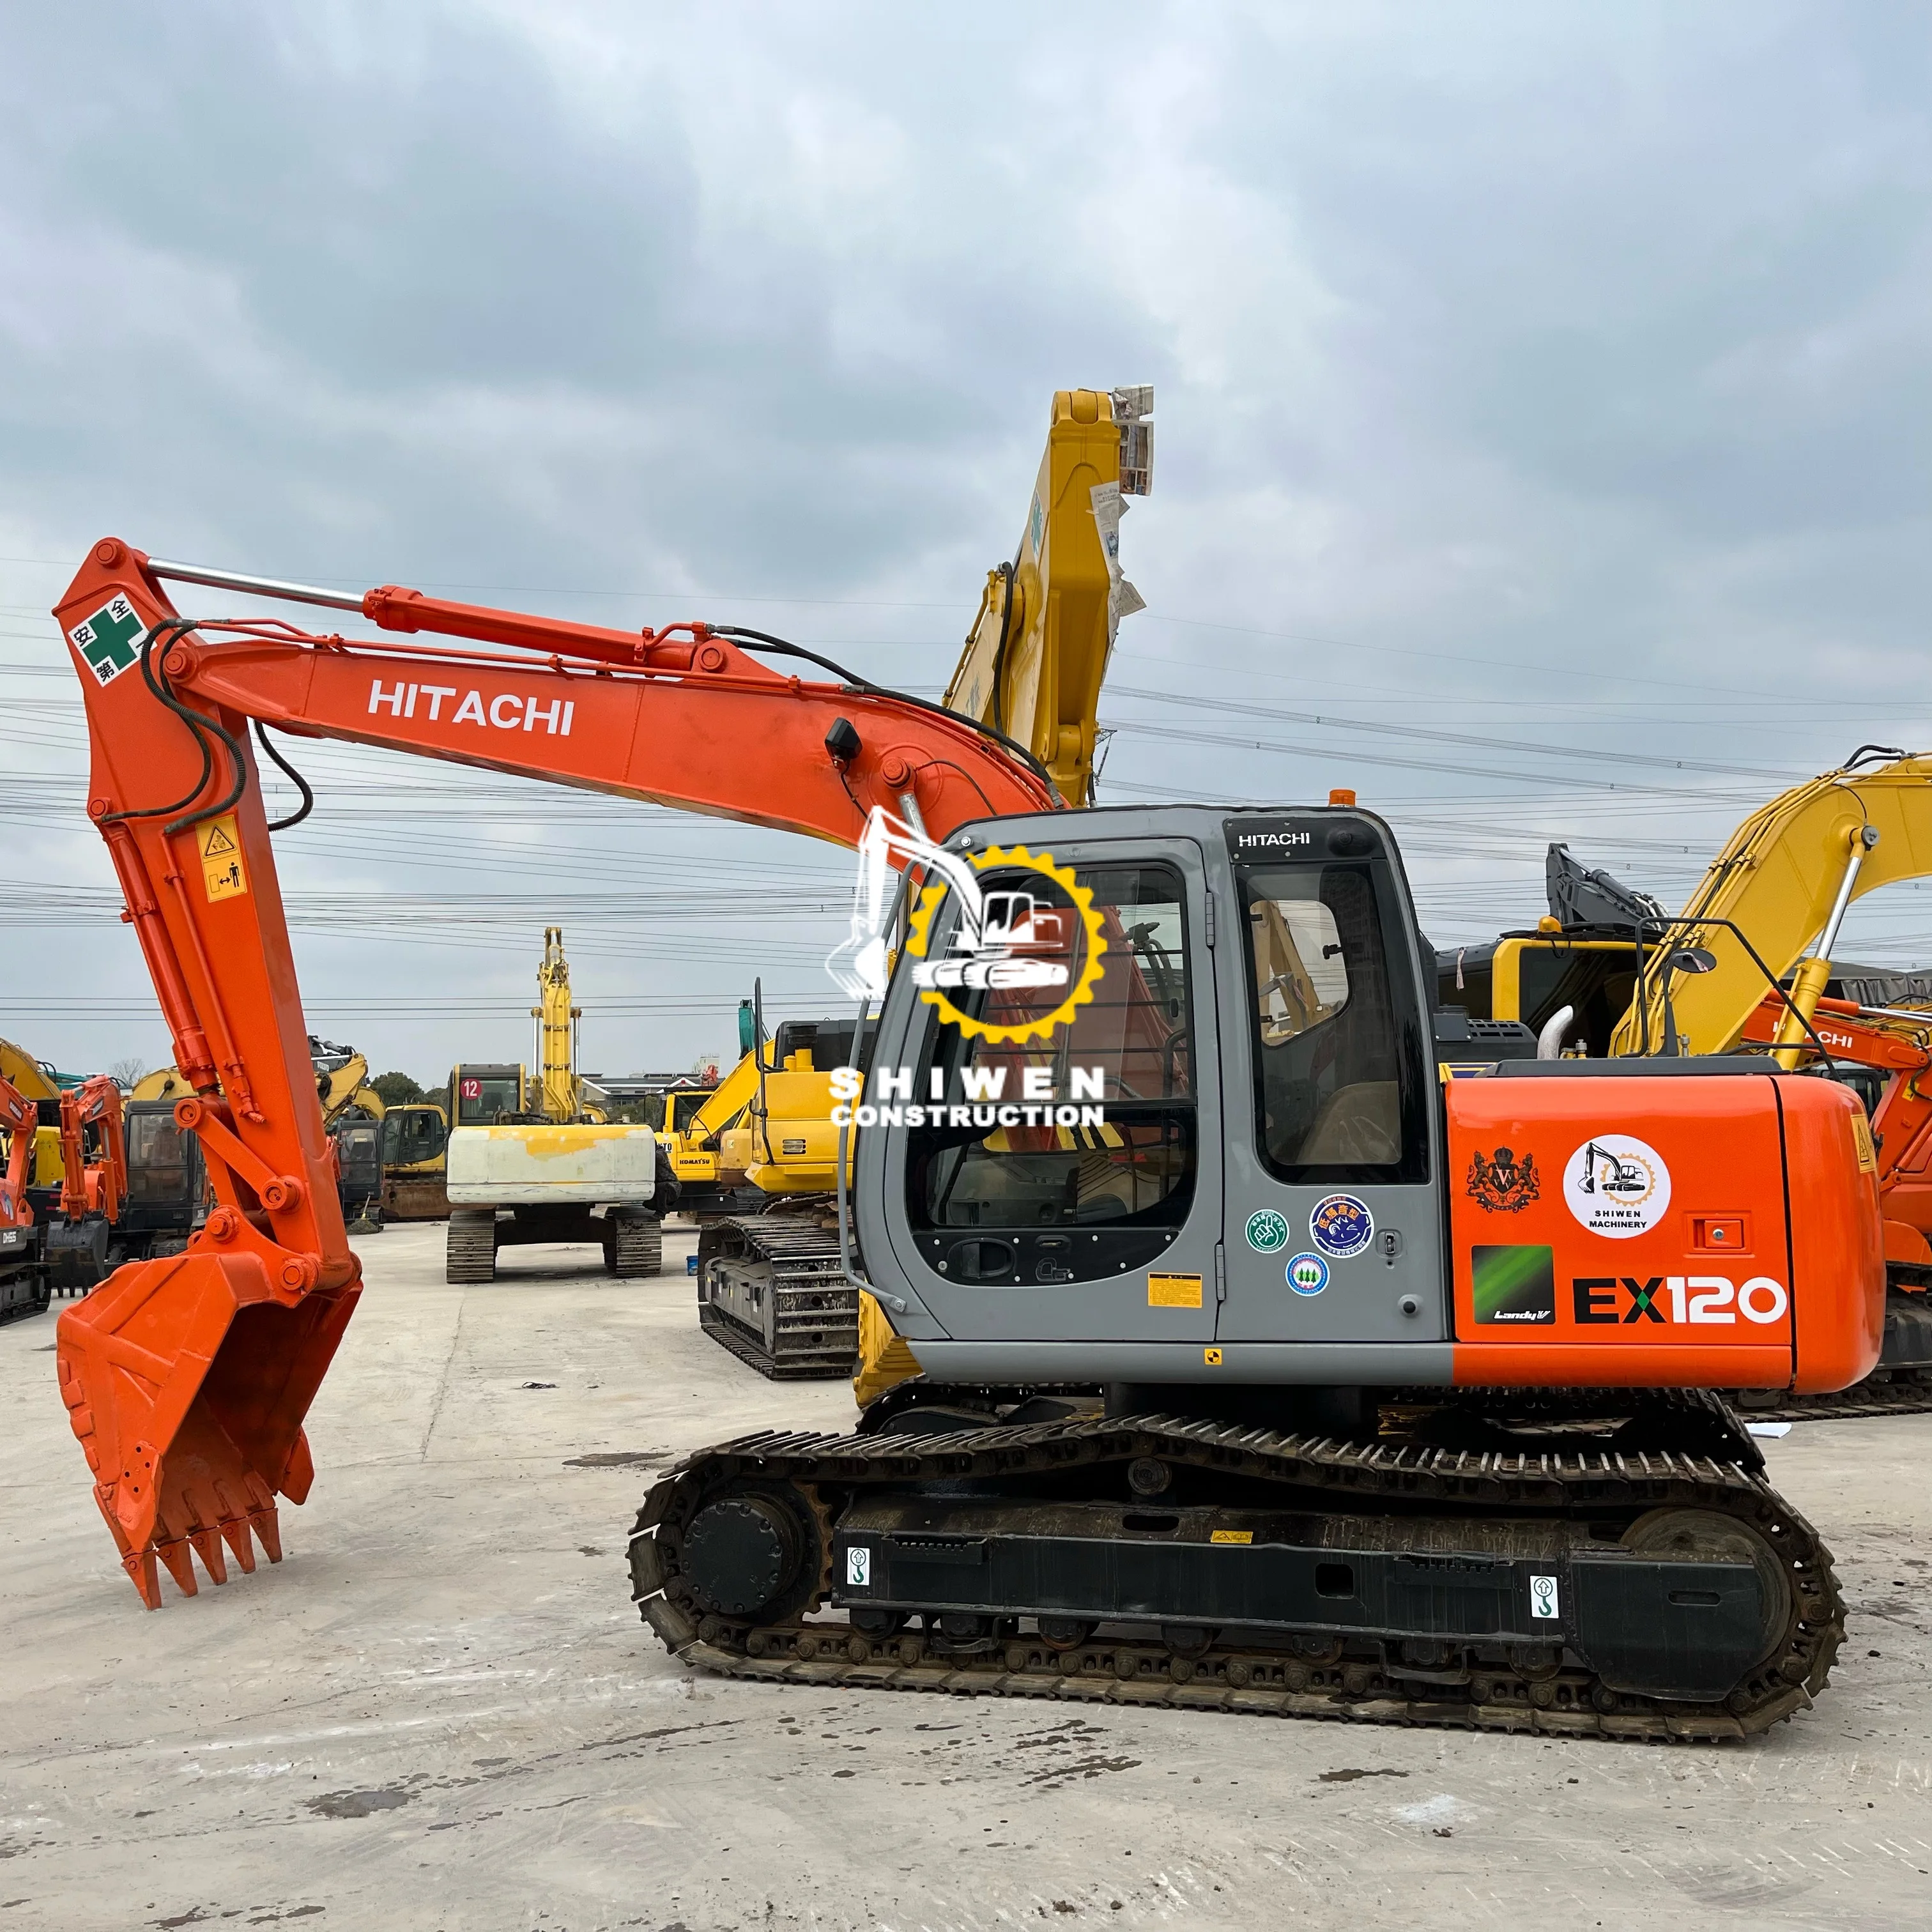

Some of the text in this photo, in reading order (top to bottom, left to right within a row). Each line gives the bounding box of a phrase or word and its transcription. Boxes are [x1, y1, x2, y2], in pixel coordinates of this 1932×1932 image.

[368, 679, 574, 736] HITACHI
[1239, 832, 1310, 847] HITACHI
[464, 1080, 477, 1096] 12
[1589, 1220, 1647, 1229] MACHINERY
[1572, 1276, 1788, 1324] EX120
